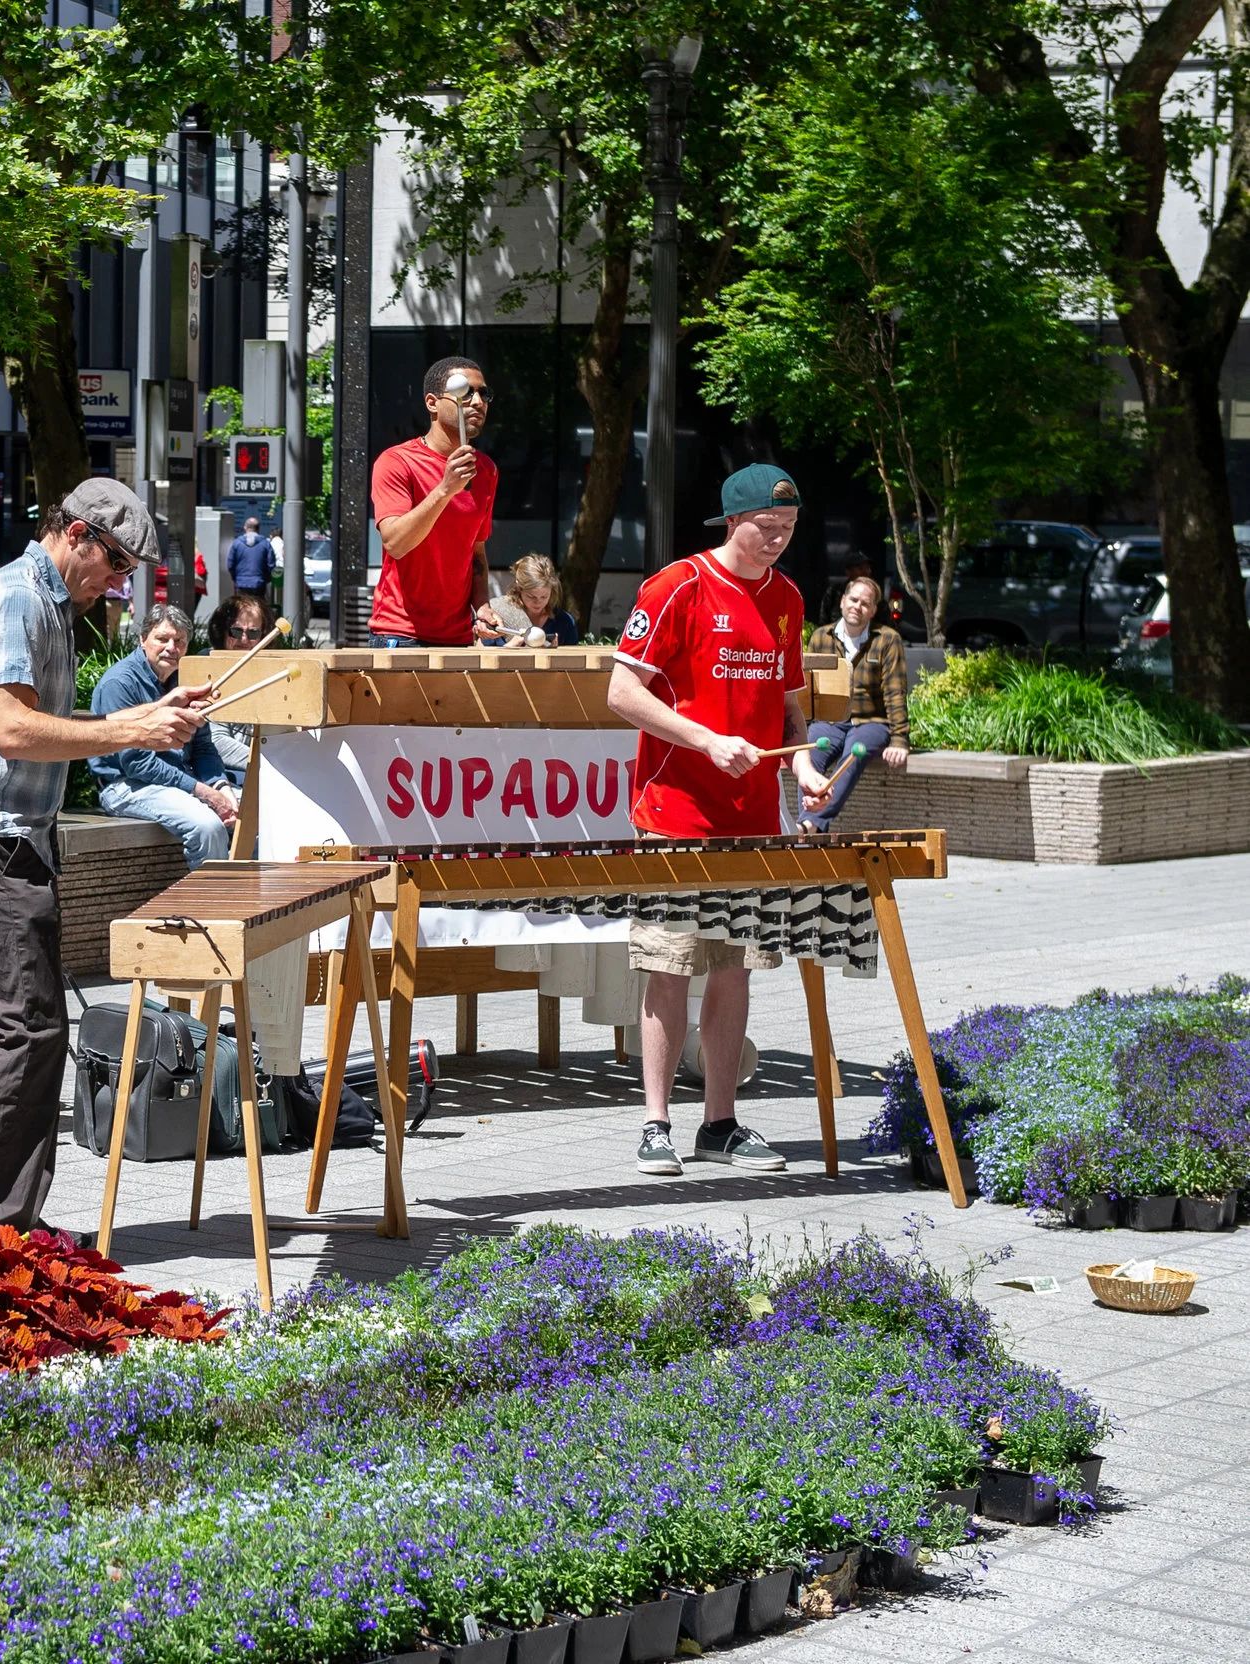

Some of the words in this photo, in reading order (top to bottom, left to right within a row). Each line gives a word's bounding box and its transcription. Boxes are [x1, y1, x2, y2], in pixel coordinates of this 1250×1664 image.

[235, 480, 248, 490] SW
[250, 480, 263, 490] 6th
[264, 481, 275, 491] Av
[718, 647, 775, 663] Standard
[712, 664, 773, 680] Chartered
